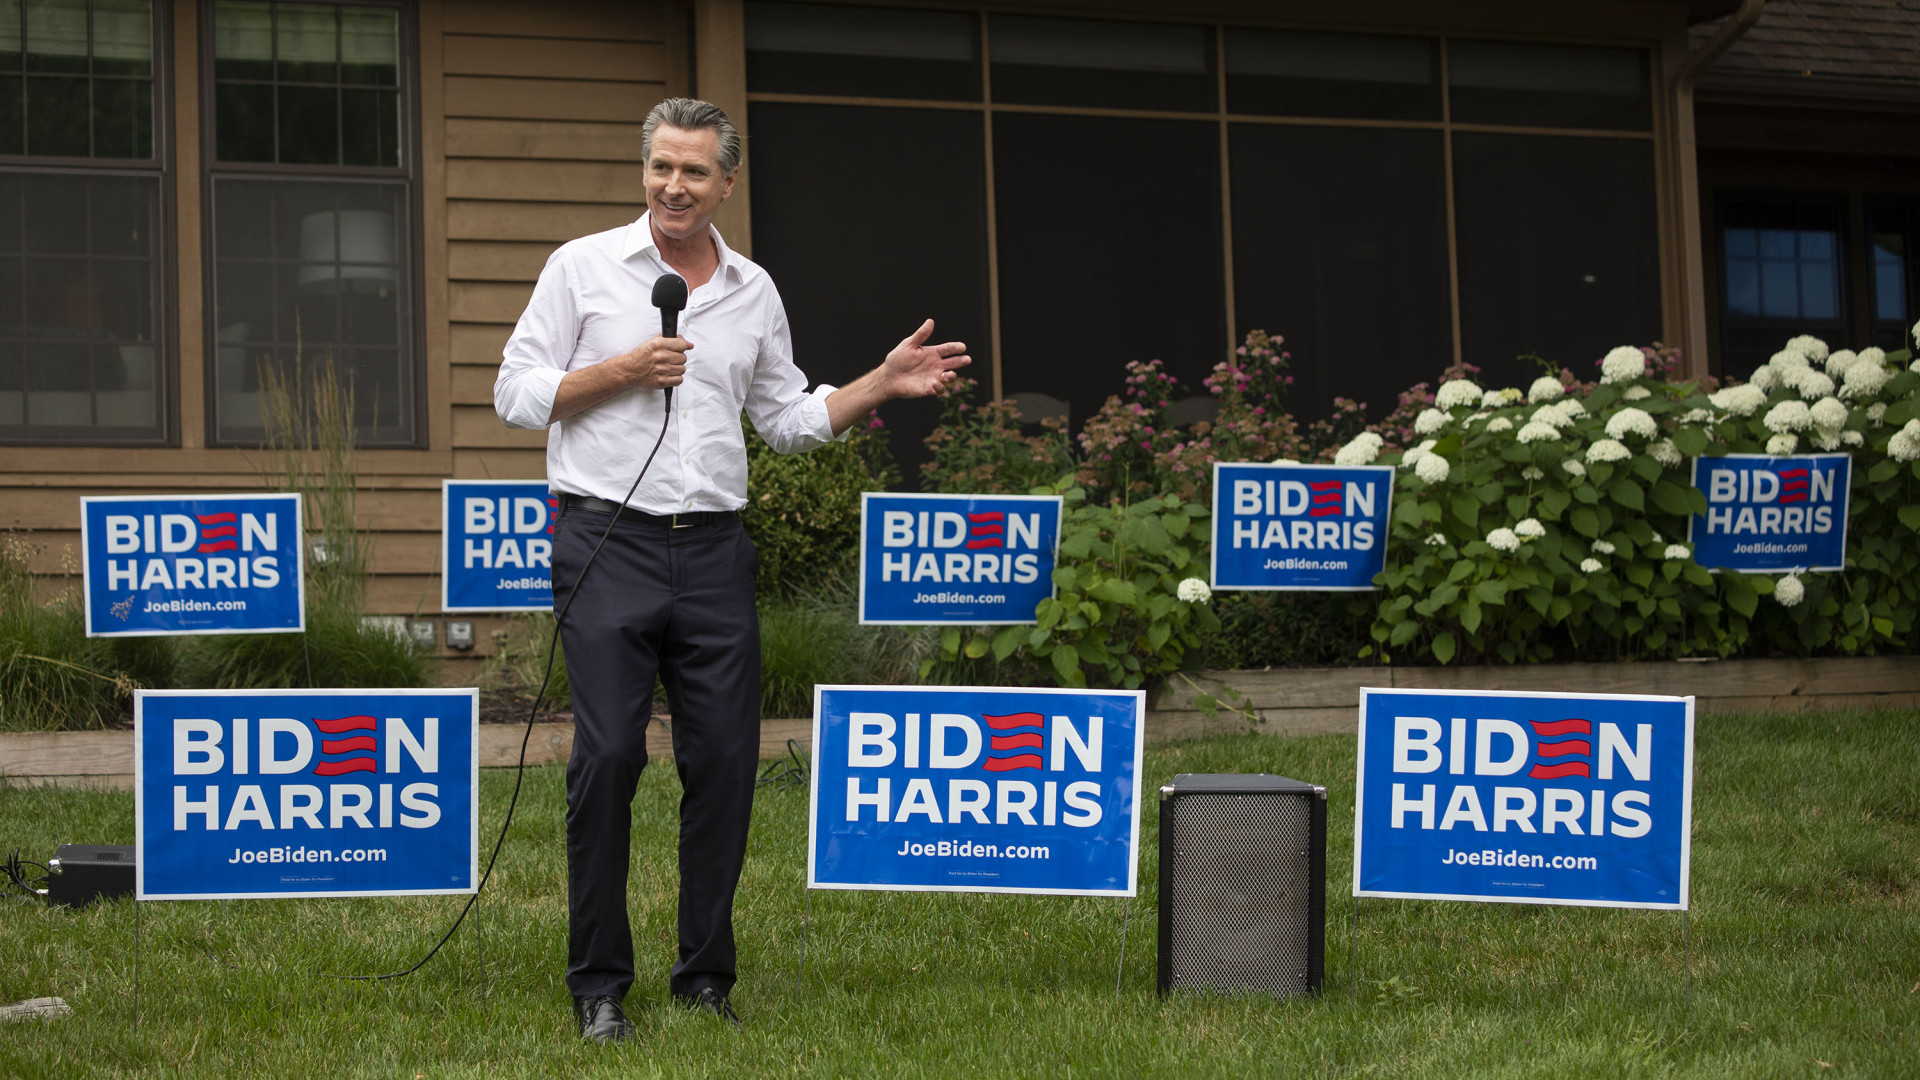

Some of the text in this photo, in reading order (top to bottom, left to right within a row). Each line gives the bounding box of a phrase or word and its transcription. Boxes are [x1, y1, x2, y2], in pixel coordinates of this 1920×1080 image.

[1234, 480, 1375, 517] BIDEN
[1710, 468, 1835, 504] BIDEN
[464, 497, 558, 534] BID
[883, 511, 1040, 550] BIDEN
[1707, 506, 1832, 534] HARRIS
[106, 512, 277, 554] BIDEN
[1233, 520, 1374, 550] HARRIS
[1733, 542, 1808, 554] JoeBiden.com
[464, 538, 552, 568] HAR
[882, 552, 1039, 584] HARRIS
[1264, 558, 1348, 570] JoeBiden.com
[108, 556, 280, 591] HARRIS
[496, 577, 552, 589] JoeBide
[144, 599, 246, 612] JoeBiden.com
[913, 592, 1005, 604] JoeBiden.com
[173, 715, 439, 776] BIDEN
[848, 712, 1104, 772] BIDEN
[1393, 716, 1652, 782] BIDEN
[173, 782, 441, 831] HARRIS
[846, 777, 1102, 828] HARRIS
[1391, 783, 1652, 838] HARRIS
[228, 846, 387, 864] JoeBiden.com
[897, 839, 1050, 859] JoeBiden.com
[1442, 849, 1597, 870] JoeBiden.com
